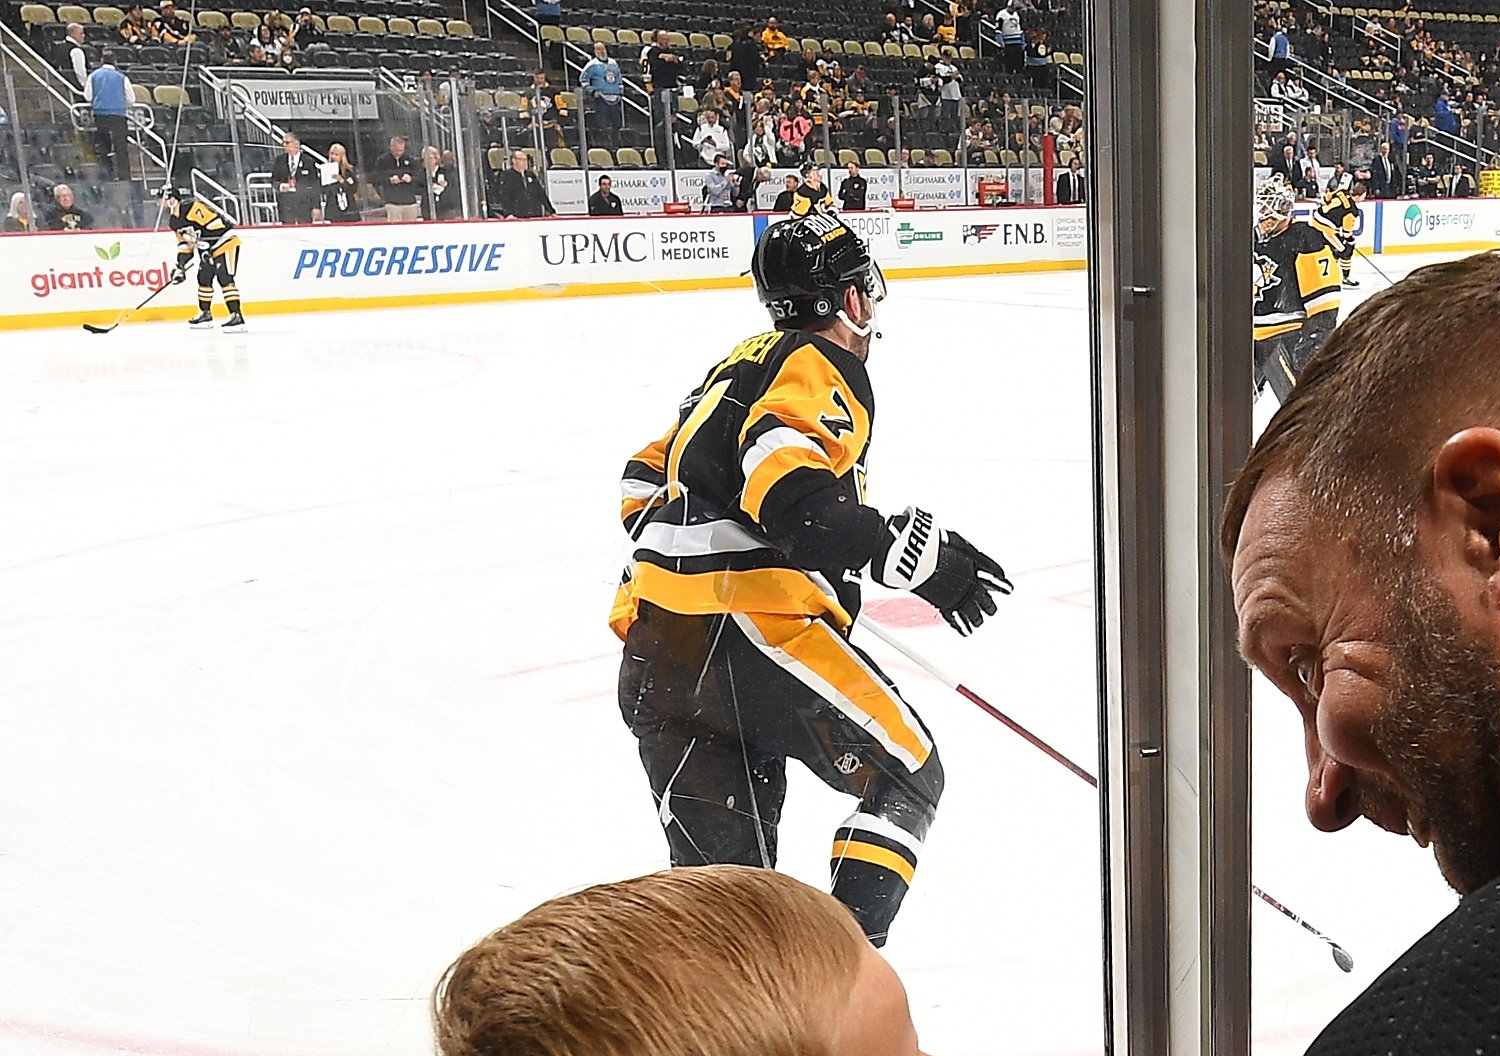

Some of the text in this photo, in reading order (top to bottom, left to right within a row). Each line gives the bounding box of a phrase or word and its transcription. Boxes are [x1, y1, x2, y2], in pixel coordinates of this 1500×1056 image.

[254, 91, 372, 110] POWERED by PENGUNS
[612, 179, 648, 188] GHMARK
[1426, 209, 1475, 231] igsenergy
[660, 231, 716, 244] SPORTS
[914, 232, 943, 240] ONLINE
[1003, 223, 1047, 245] F.N.B.
[539, 232, 648, 266] UPMC
[661, 247, 730, 261] MEDICINE
[293, 243, 505, 279] PROGRESSIVE
[1318, 257, 1329, 277] 7
[31, 262, 169, 297] giant eagl
[772, 301, 797, 318] 52
[896, 506, 934, 582] WARR
